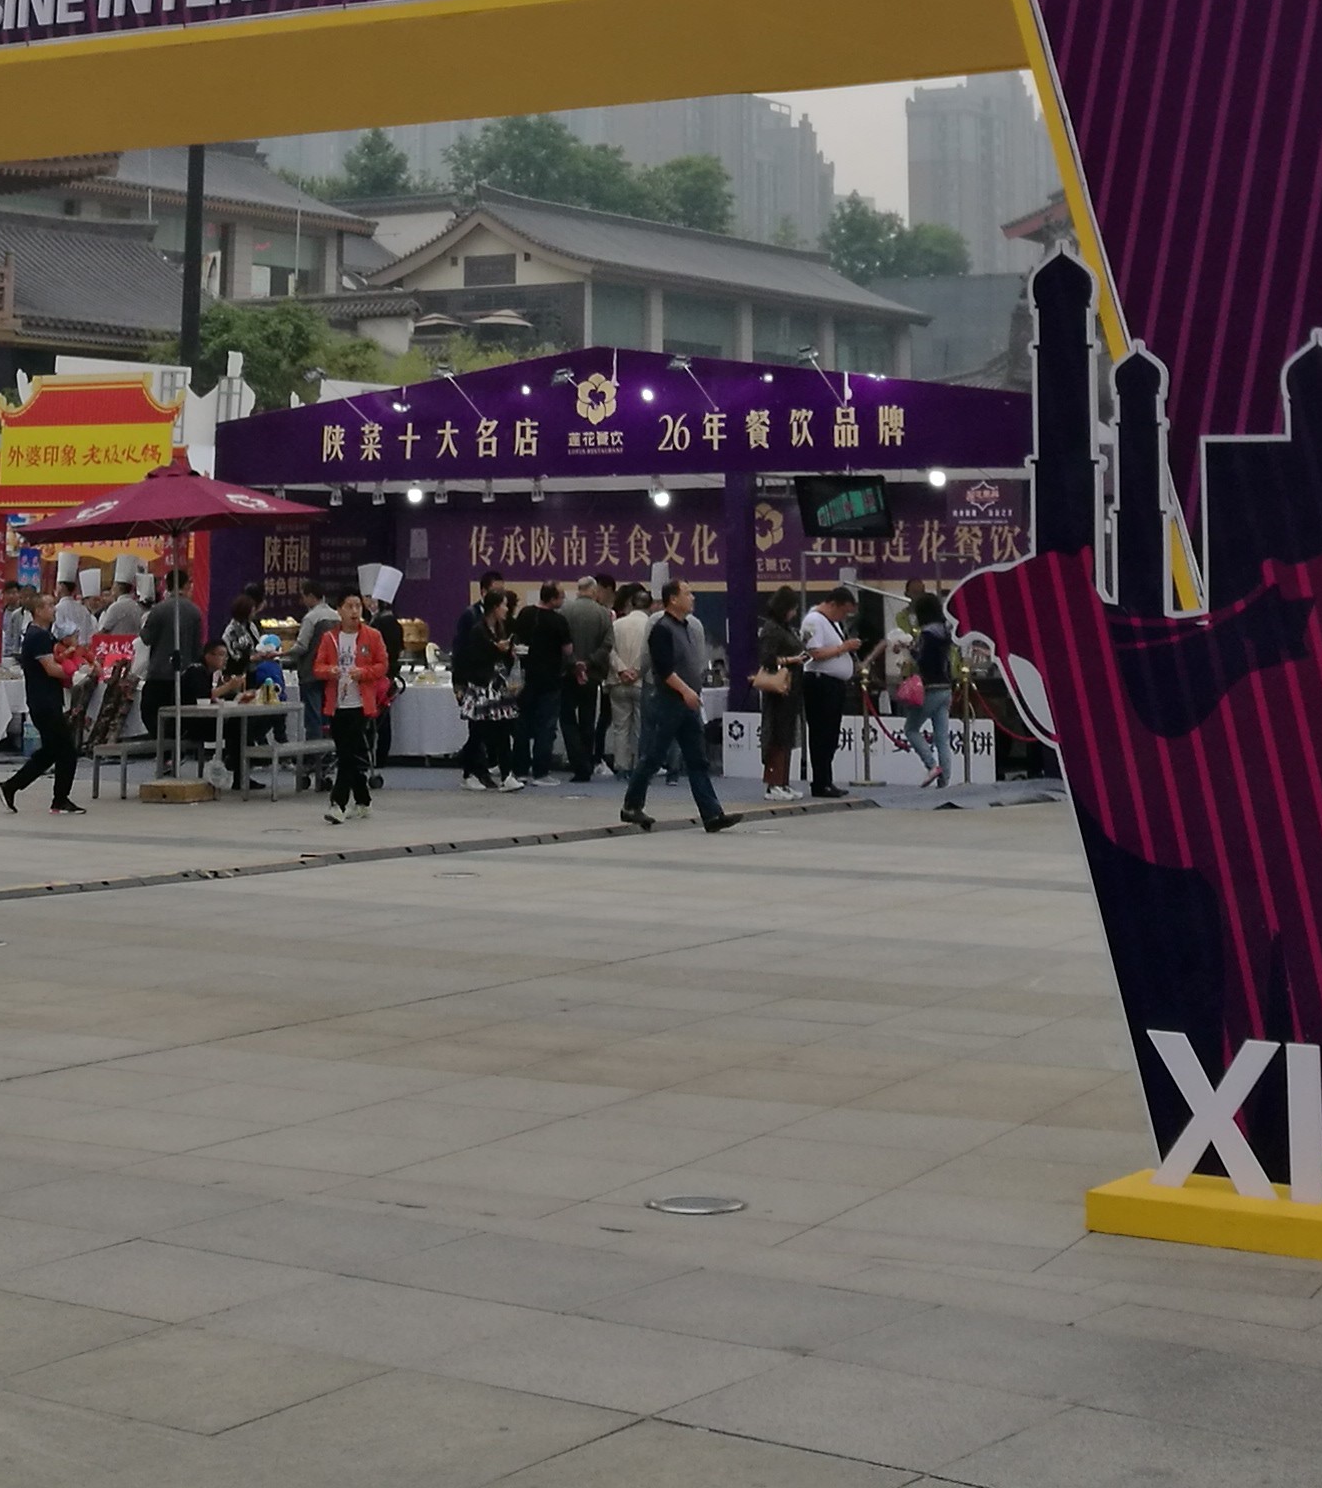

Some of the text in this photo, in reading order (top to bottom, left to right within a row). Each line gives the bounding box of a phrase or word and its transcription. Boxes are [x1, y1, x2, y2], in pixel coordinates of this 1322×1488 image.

[321, 417, 540, 463] 陕菜十大名店
[657, 404, 905, 452] 26年餐饮品牌
[7, 443, 77, 467] 外婆印象
[468, 522, 720, 567] 传承陕南美食文化
[891, 728, 994, 756] 安烧饼
